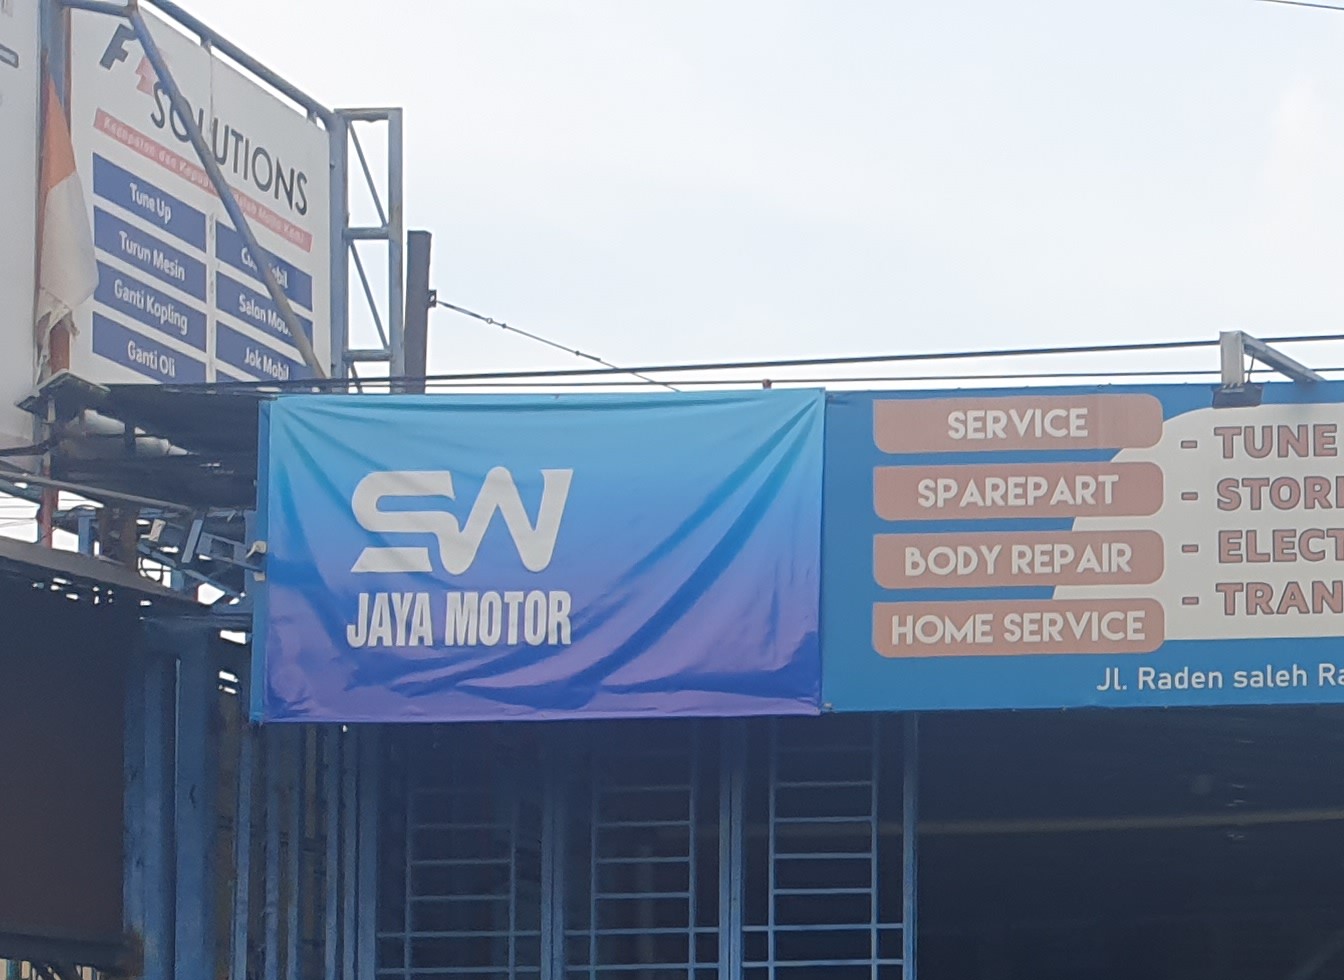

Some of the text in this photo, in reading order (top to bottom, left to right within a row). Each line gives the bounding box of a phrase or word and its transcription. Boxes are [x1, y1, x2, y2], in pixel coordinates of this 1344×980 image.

[129, 183, 172, 224] Tune Up
[119, 231, 185, 281] Turun Mesin
[114, 279, 188, 336] Ganti Kopling
[239, 293, 266, 322] Salon
[127, 340, 176, 377] Ganti Oli
[244, 347, 289, 381] Jok Mobil
[946, 406, 1089, 440] SERVICE
[1214, 423, 1338, 459] TUNE
[917, 474, 1120, 508] SPAREPART
[904, 542, 1132, 577] BODY REPAIR
[346, 590, 572, 649] JAYA MOTOR
[891, 610, 1146, 645] HOME SERVICE
[1097, 667, 1127, 692] Jl.
[1137, 665, 1223, 692] Raden
[1232, 663, 1305, 689] saleh
